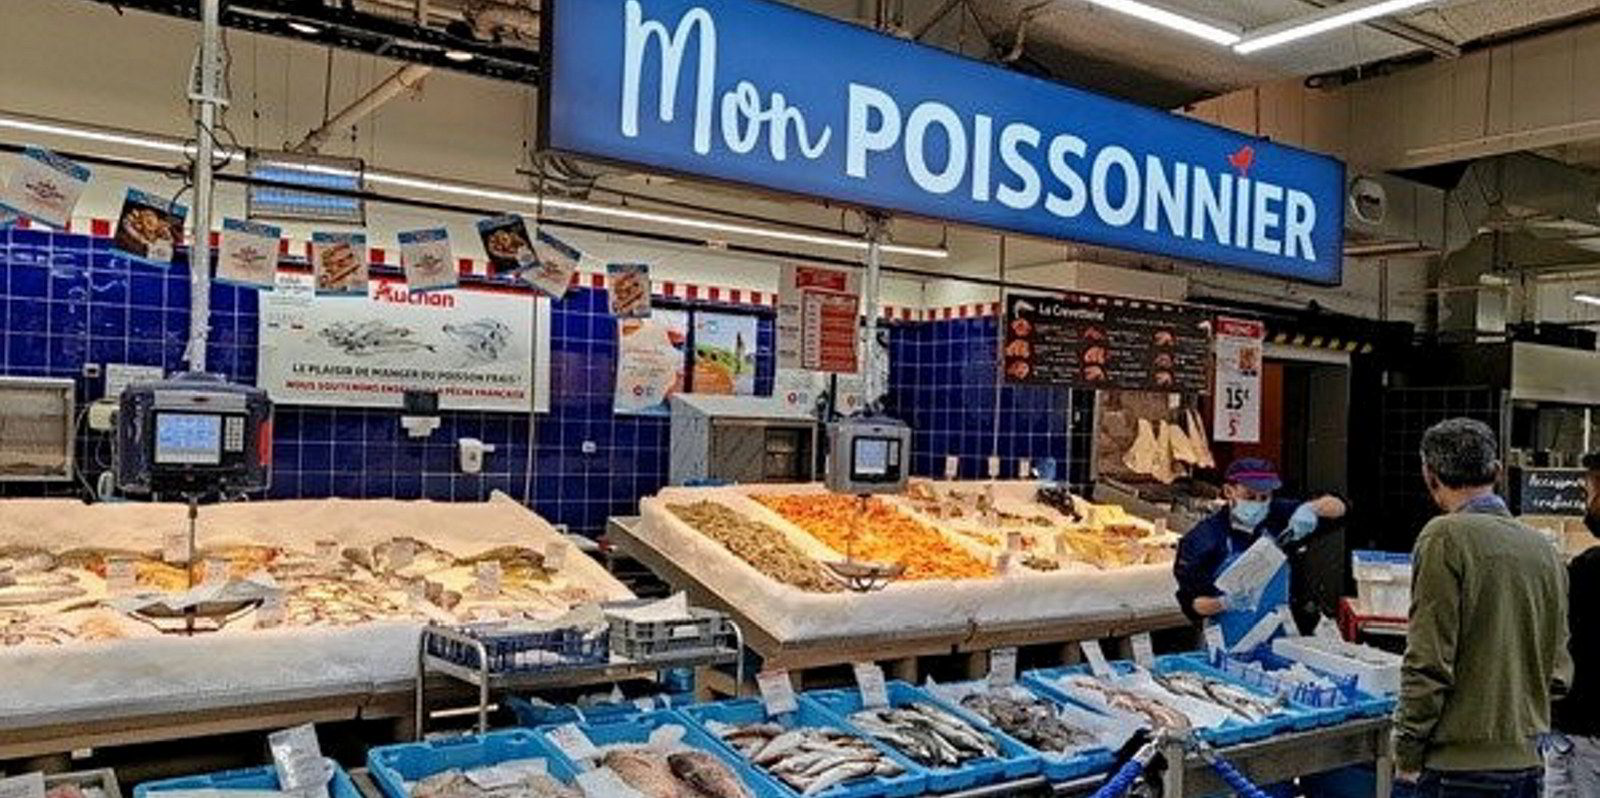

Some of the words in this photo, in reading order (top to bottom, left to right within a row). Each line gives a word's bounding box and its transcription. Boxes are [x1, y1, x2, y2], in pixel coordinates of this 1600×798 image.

[620, 0, 831, 161] Mon
[846, 83, 1317, 262] POISSONNIER
[373, 280, 454, 307] Auchan
[293, 364, 305, 373] LE
[308, 365, 353, 375] PLAISIR
[355, 368, 369, 376] DE
[371, 368, 418, 378] MANGER
[438, 372, 483, 382] POISSON
[286, 381, 315, 390] NOUS
